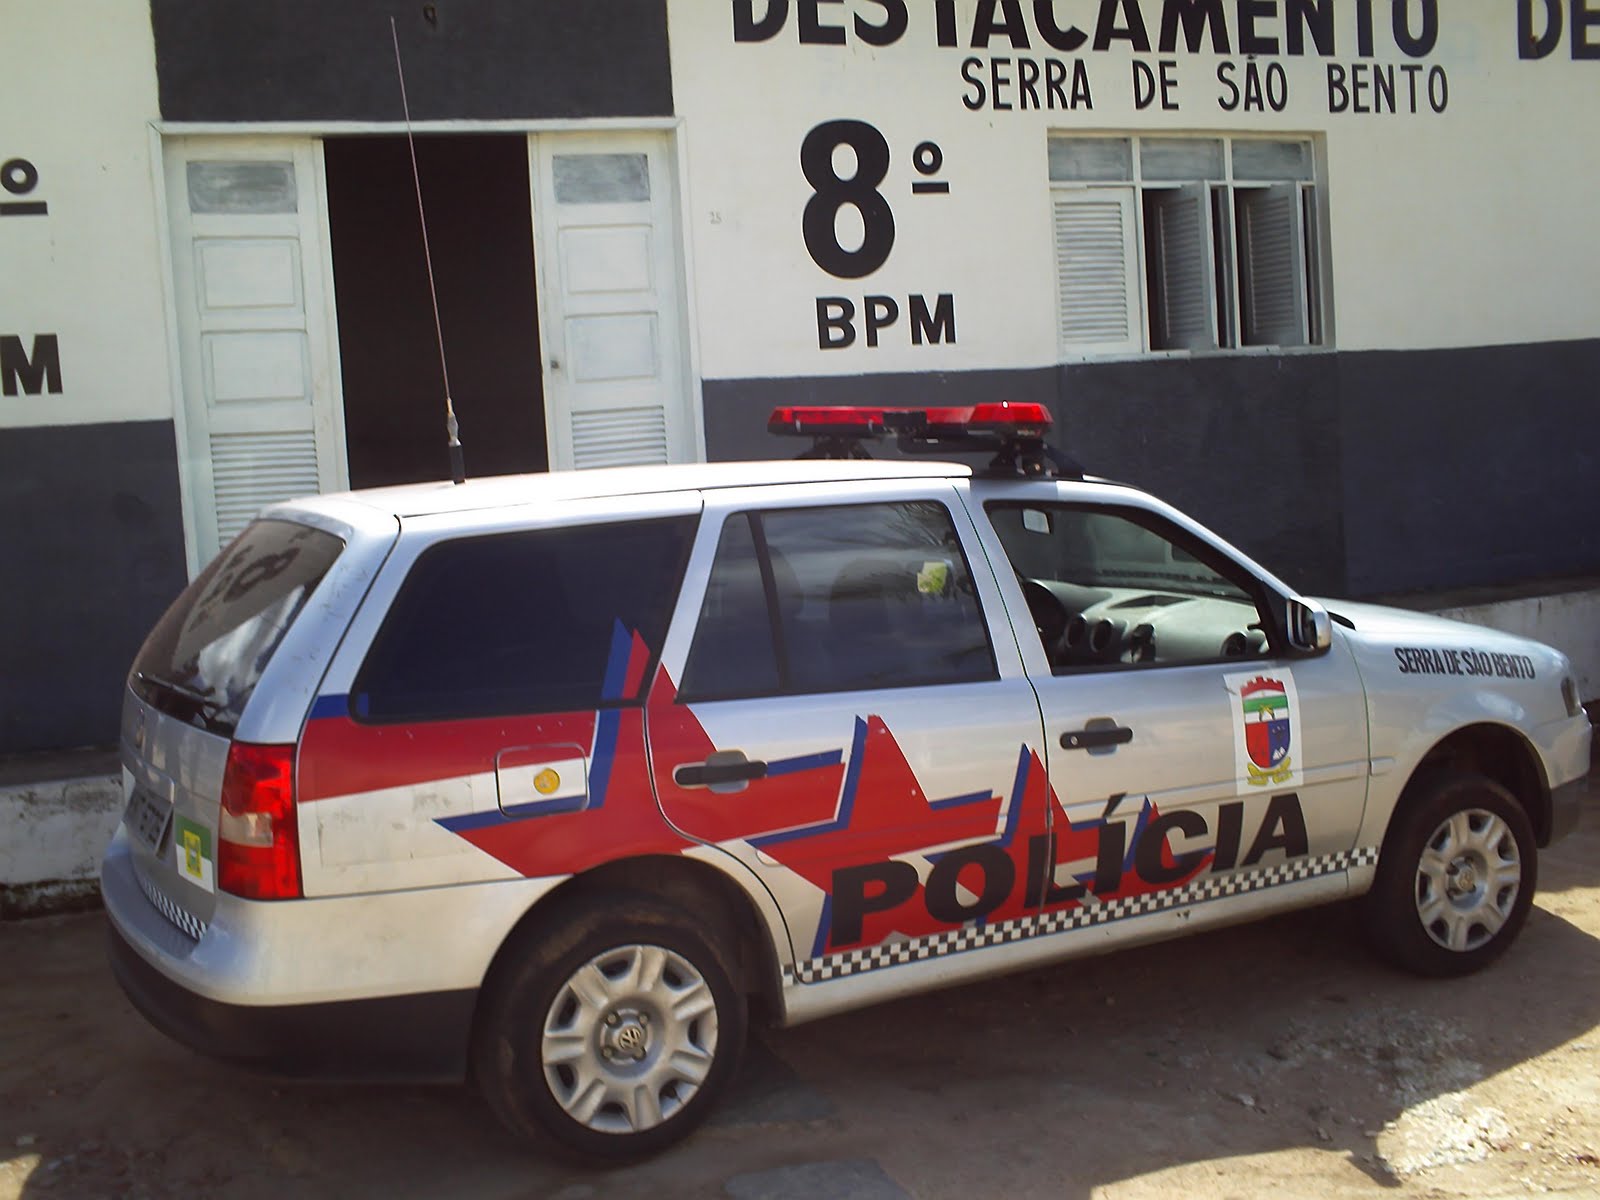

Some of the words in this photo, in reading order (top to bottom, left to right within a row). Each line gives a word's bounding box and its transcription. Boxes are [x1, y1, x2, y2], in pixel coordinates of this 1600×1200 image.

[960, 57, 1093, 111] SERRA
[1132, 60, 1180, 110] DE
[1216, 55, 1288, 111] SÃO
[1327, 63, 1448, 114] BENTO
[816, 293, 956, 350] BPM
[1394, 647, 1446, 675] SERRA
[1443, 649, 1465, 676] DE
[1461, 647, 1493, 677] SÃO
[1491, 652, 1536, 680] BENTO
[831, 791, 1309, 947] POLÍCIA
